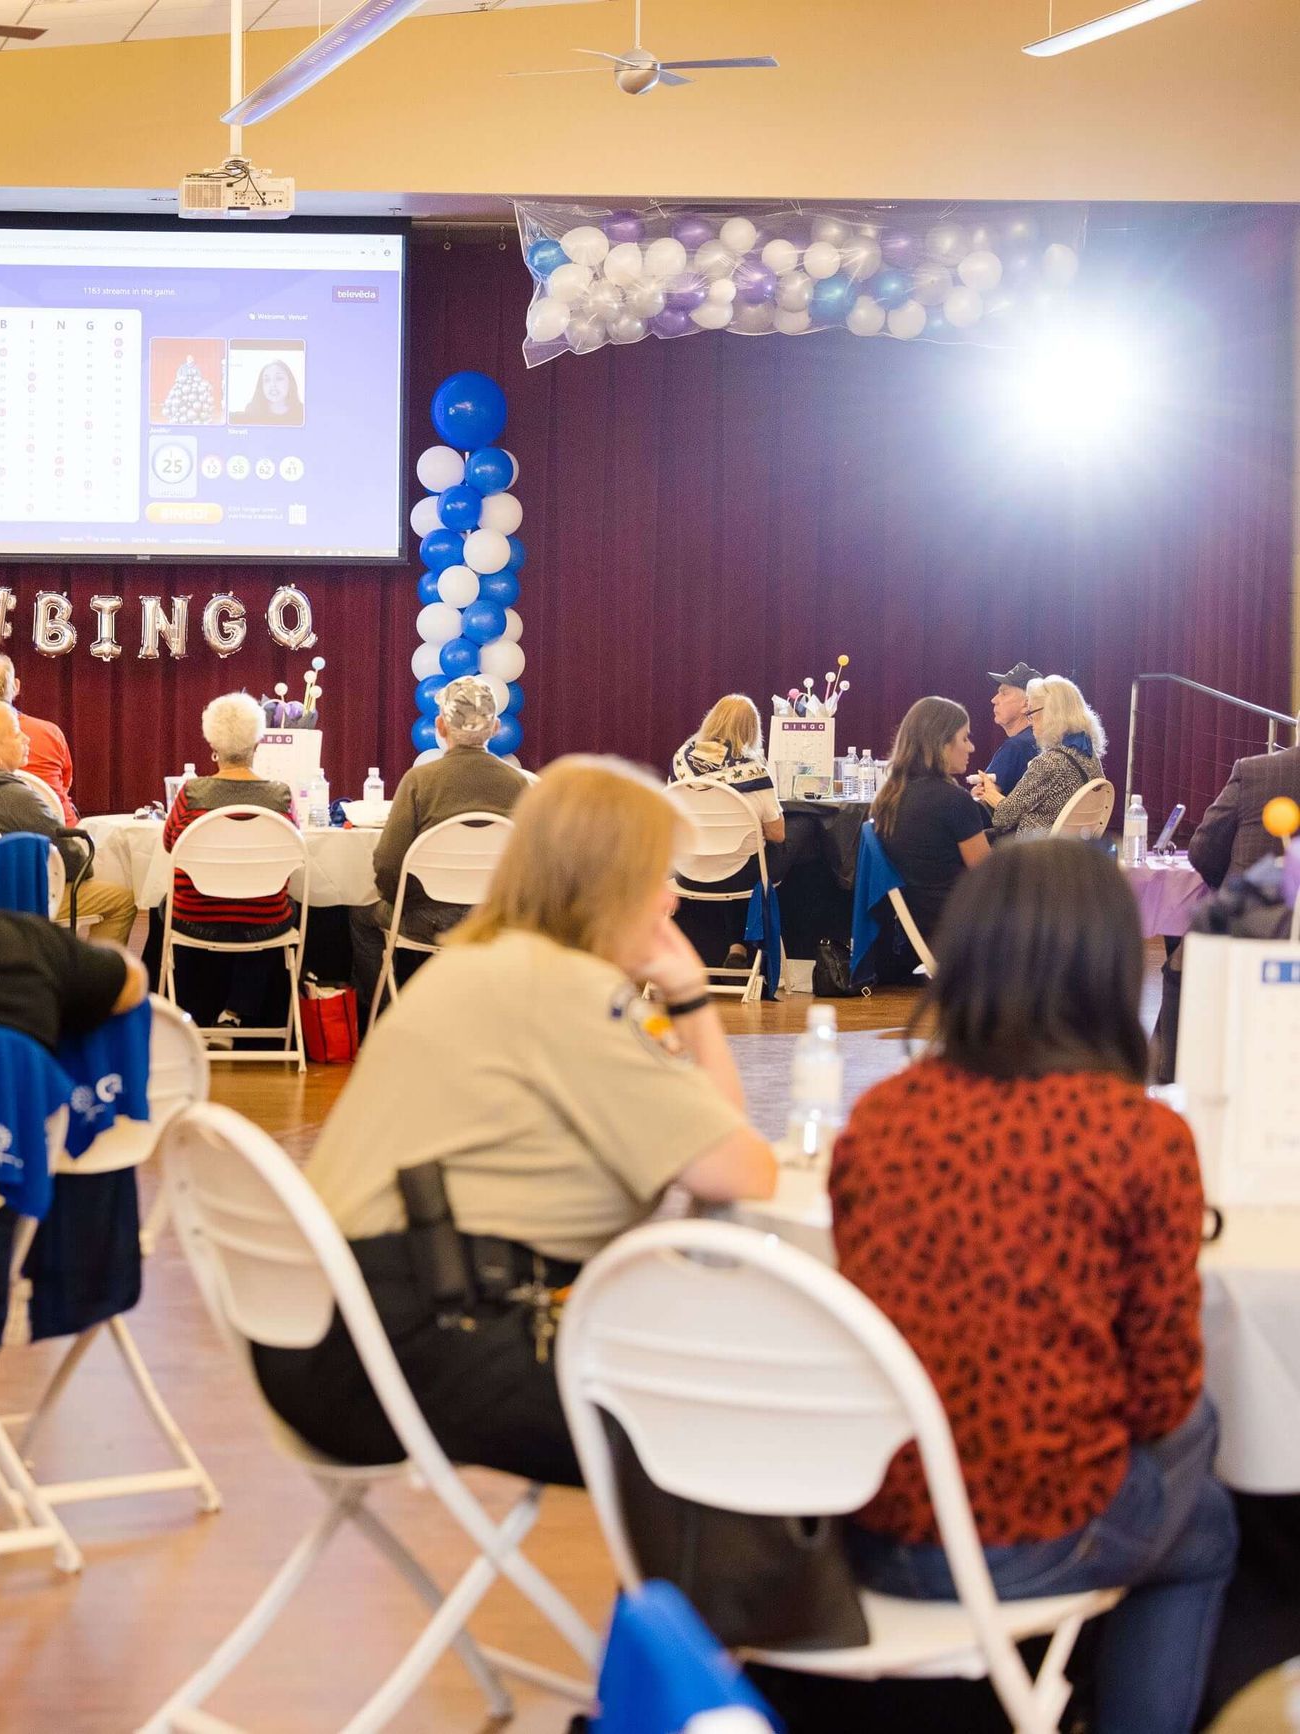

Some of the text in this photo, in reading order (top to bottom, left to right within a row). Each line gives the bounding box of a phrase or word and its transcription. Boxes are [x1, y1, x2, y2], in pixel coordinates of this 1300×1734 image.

[102, 287, 130, 296] streams
[140, 288, 153, 296] the
[162, 459, 182, 474] 25
[206, 465, 218, 474] 12
[232, 465, 245, 474] 58
